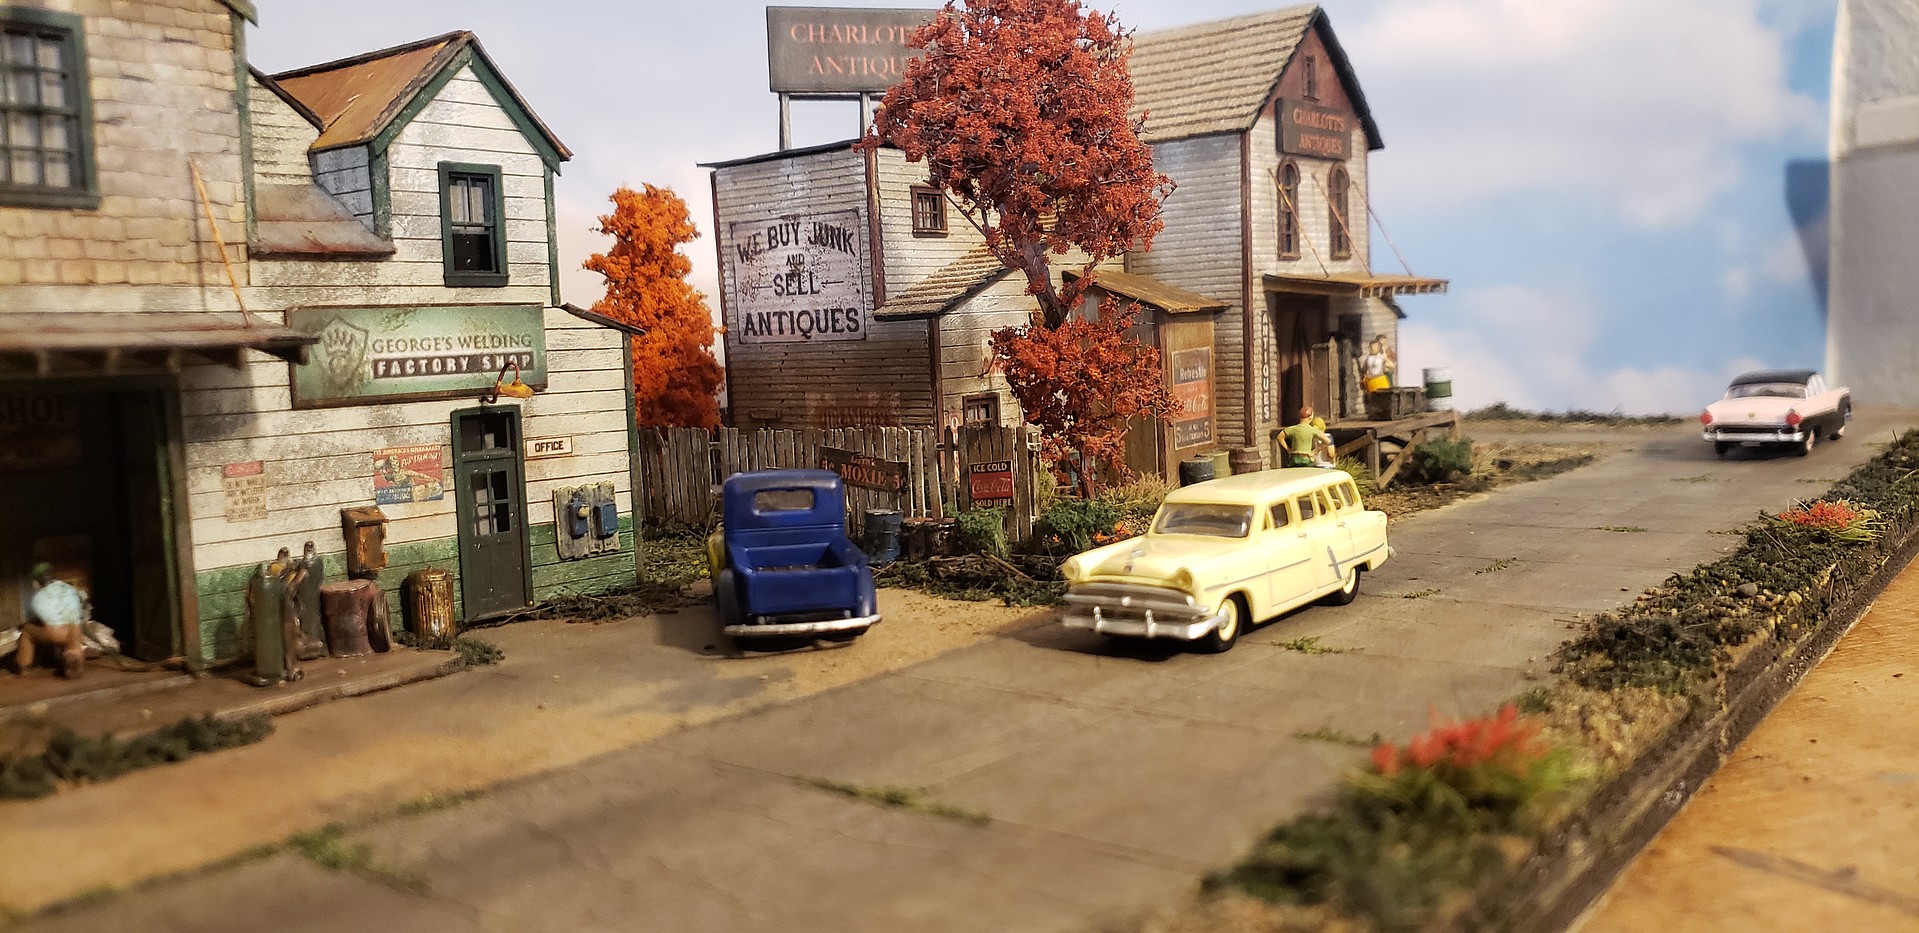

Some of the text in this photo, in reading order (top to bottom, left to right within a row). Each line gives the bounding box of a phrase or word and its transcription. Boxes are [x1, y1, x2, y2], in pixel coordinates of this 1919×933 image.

[790, 23, 912, 45] CHARLOT
[810, 55, 906, 81] ANTIQU
[1299, 134, 1343, 156] ANTIQUES
[736, 221, 856, 264] WE BUY JUNK
[786, 253, 805, 267] AND
[773, 271, 821, 297] SELL
[743, 307, 860, 339] ANTIQUES
[372, 332, 533, 354] GEORGE'S WELDING
[376, 353, 532, 377] FACTORY SHOP
[1262, 311, 1270, 420] ANTIQUES
[534, 440, 565, 452] OFFICE
[841, 463, 887, 486] MOXIE
[973, 462, 1008, 473] ICE COLD
[975, 499, 993, 507] SOLD
